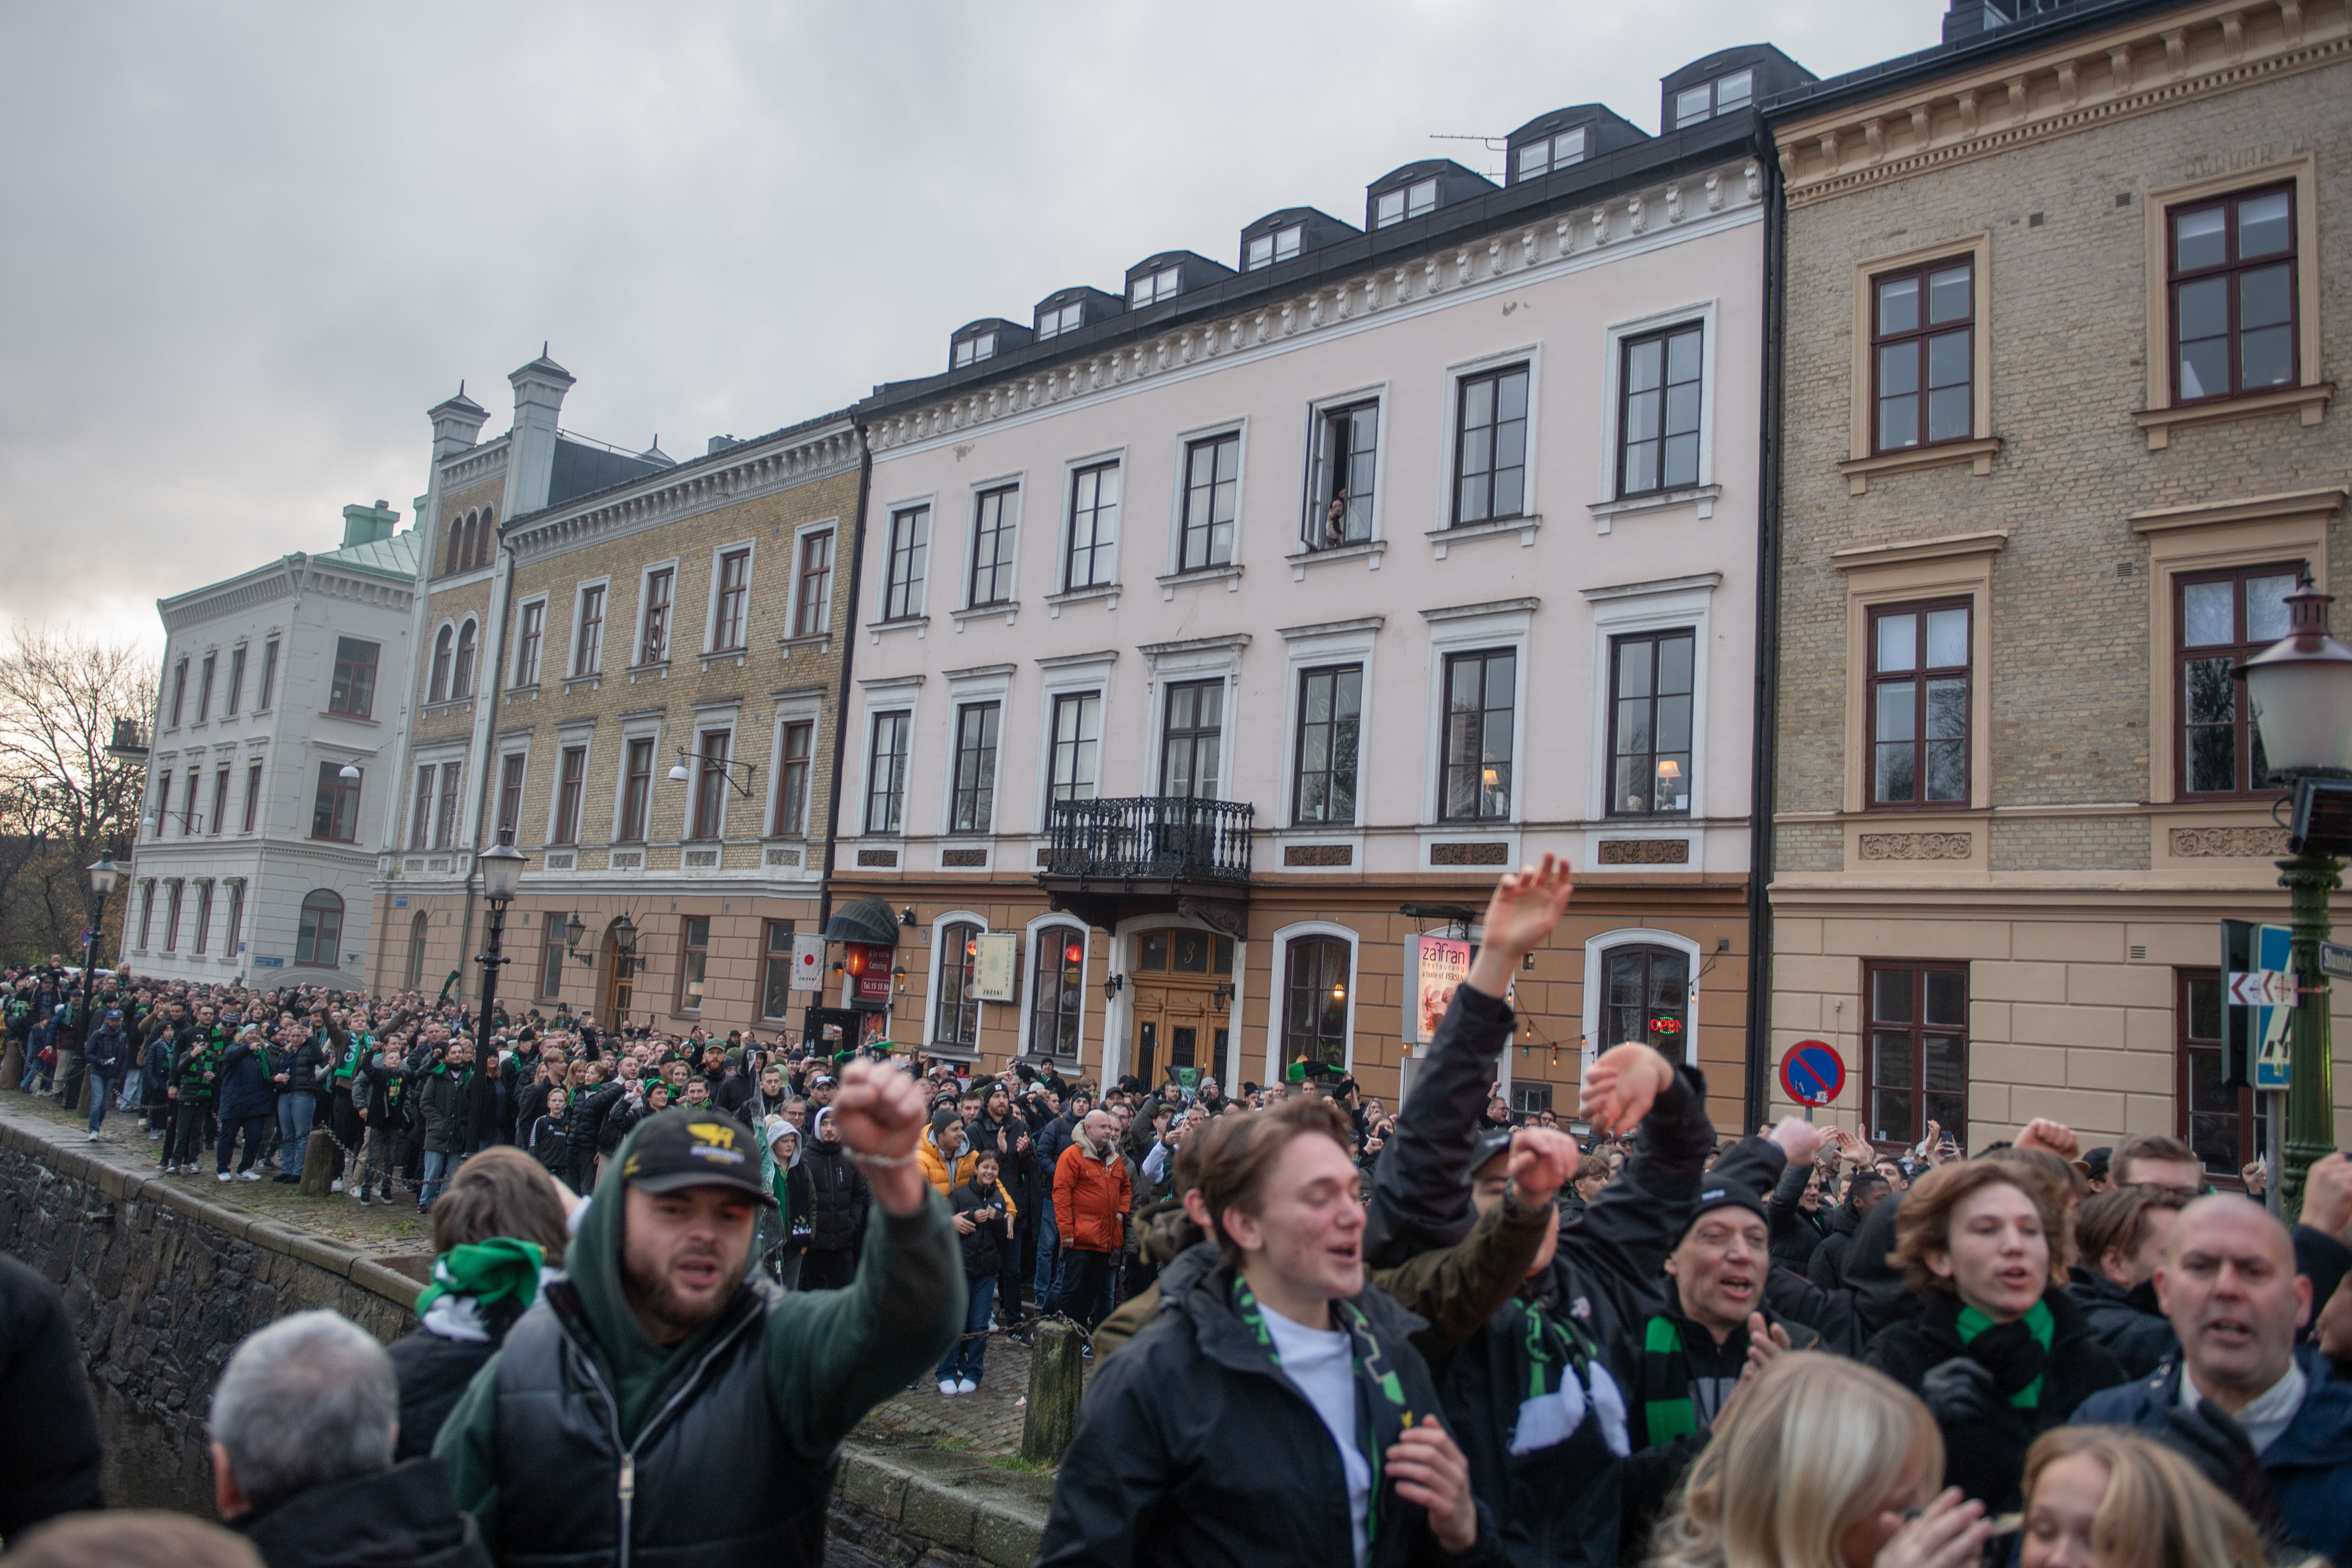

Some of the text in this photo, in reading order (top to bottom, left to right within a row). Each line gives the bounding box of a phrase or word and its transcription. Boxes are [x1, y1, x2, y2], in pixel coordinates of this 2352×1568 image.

[1184, 941, 1195, 963] 3
[1423, 942, 1465, 965] zaffran
[869, 960, 888, 972] Catering
[1422, 960, 1464, 973] Restaurang
[1446, 972, 1464, 982] PERSIA
